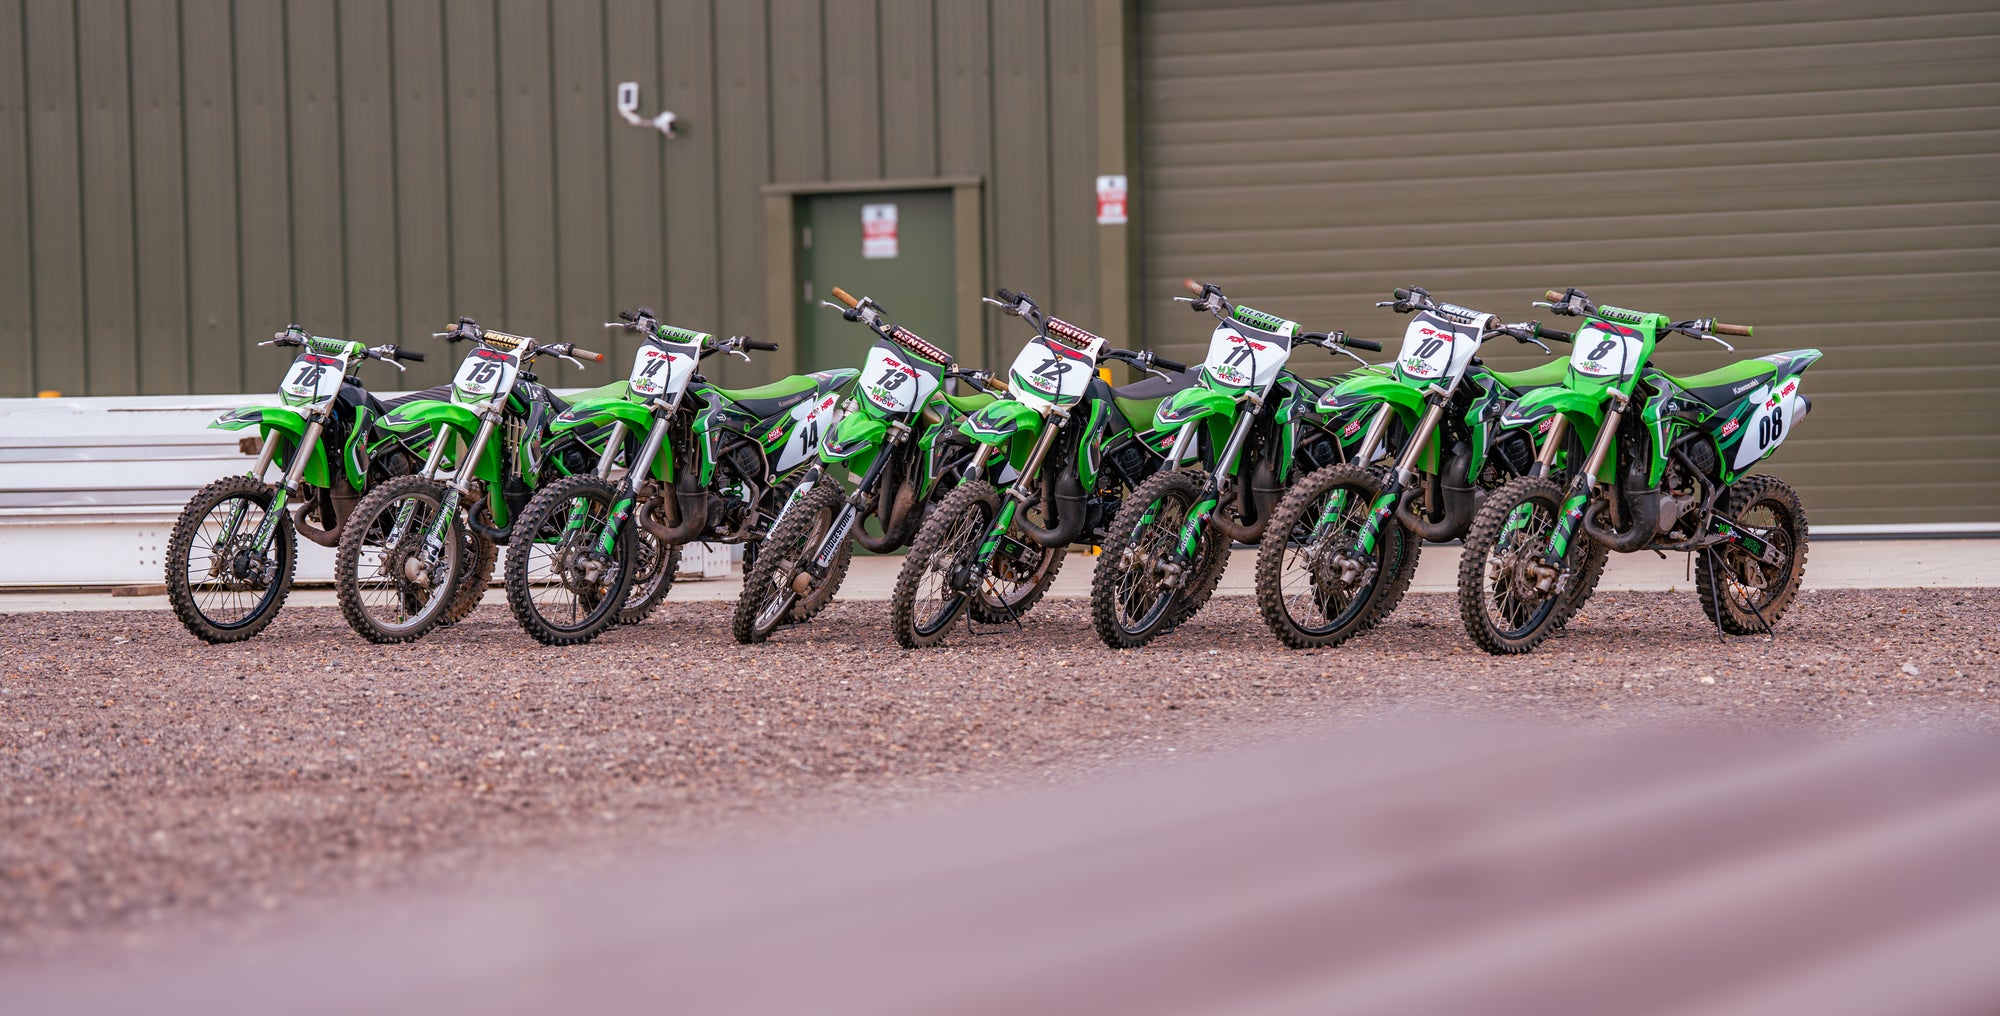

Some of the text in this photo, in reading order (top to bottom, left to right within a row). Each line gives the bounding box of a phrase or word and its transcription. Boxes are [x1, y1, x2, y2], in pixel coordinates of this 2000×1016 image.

[1236, 315, 1278, 332] RENTH
[1239, 307, 1286, 324] RENTHA
[1601, 309, 1643, 323] RENTH
[484, 331, 524, 345] RENTHA
[661, 328, 694, 341] RENTH
[1048, 321, 1094, 343] RENTHA
[893, 330, 946, 363] RENTHAL
[1223, 346, 1254, 367] 11
[1413, 337, 1444, 359] 10
[1587, 339, 1617, 361] 8
[465, 361, 501, 384] 15
[639, 358, 666, 378] 14
[882, 356, 901, 369] FOR
[1032, 358, 1073, 382] 12
[292, 365, 327, 387] 16
[875, 368, 909, 391] 13
[820, 396, 835, 412] HIRE
[1765, 381, 1797, 411] FO HIRE
[1722, 418, 1738, 433] NGK
[1759, 406, 1783, 450] 08
[799, 420, 819, 456] 14
[820, 511, 854, 563] BRIDGESTONE
